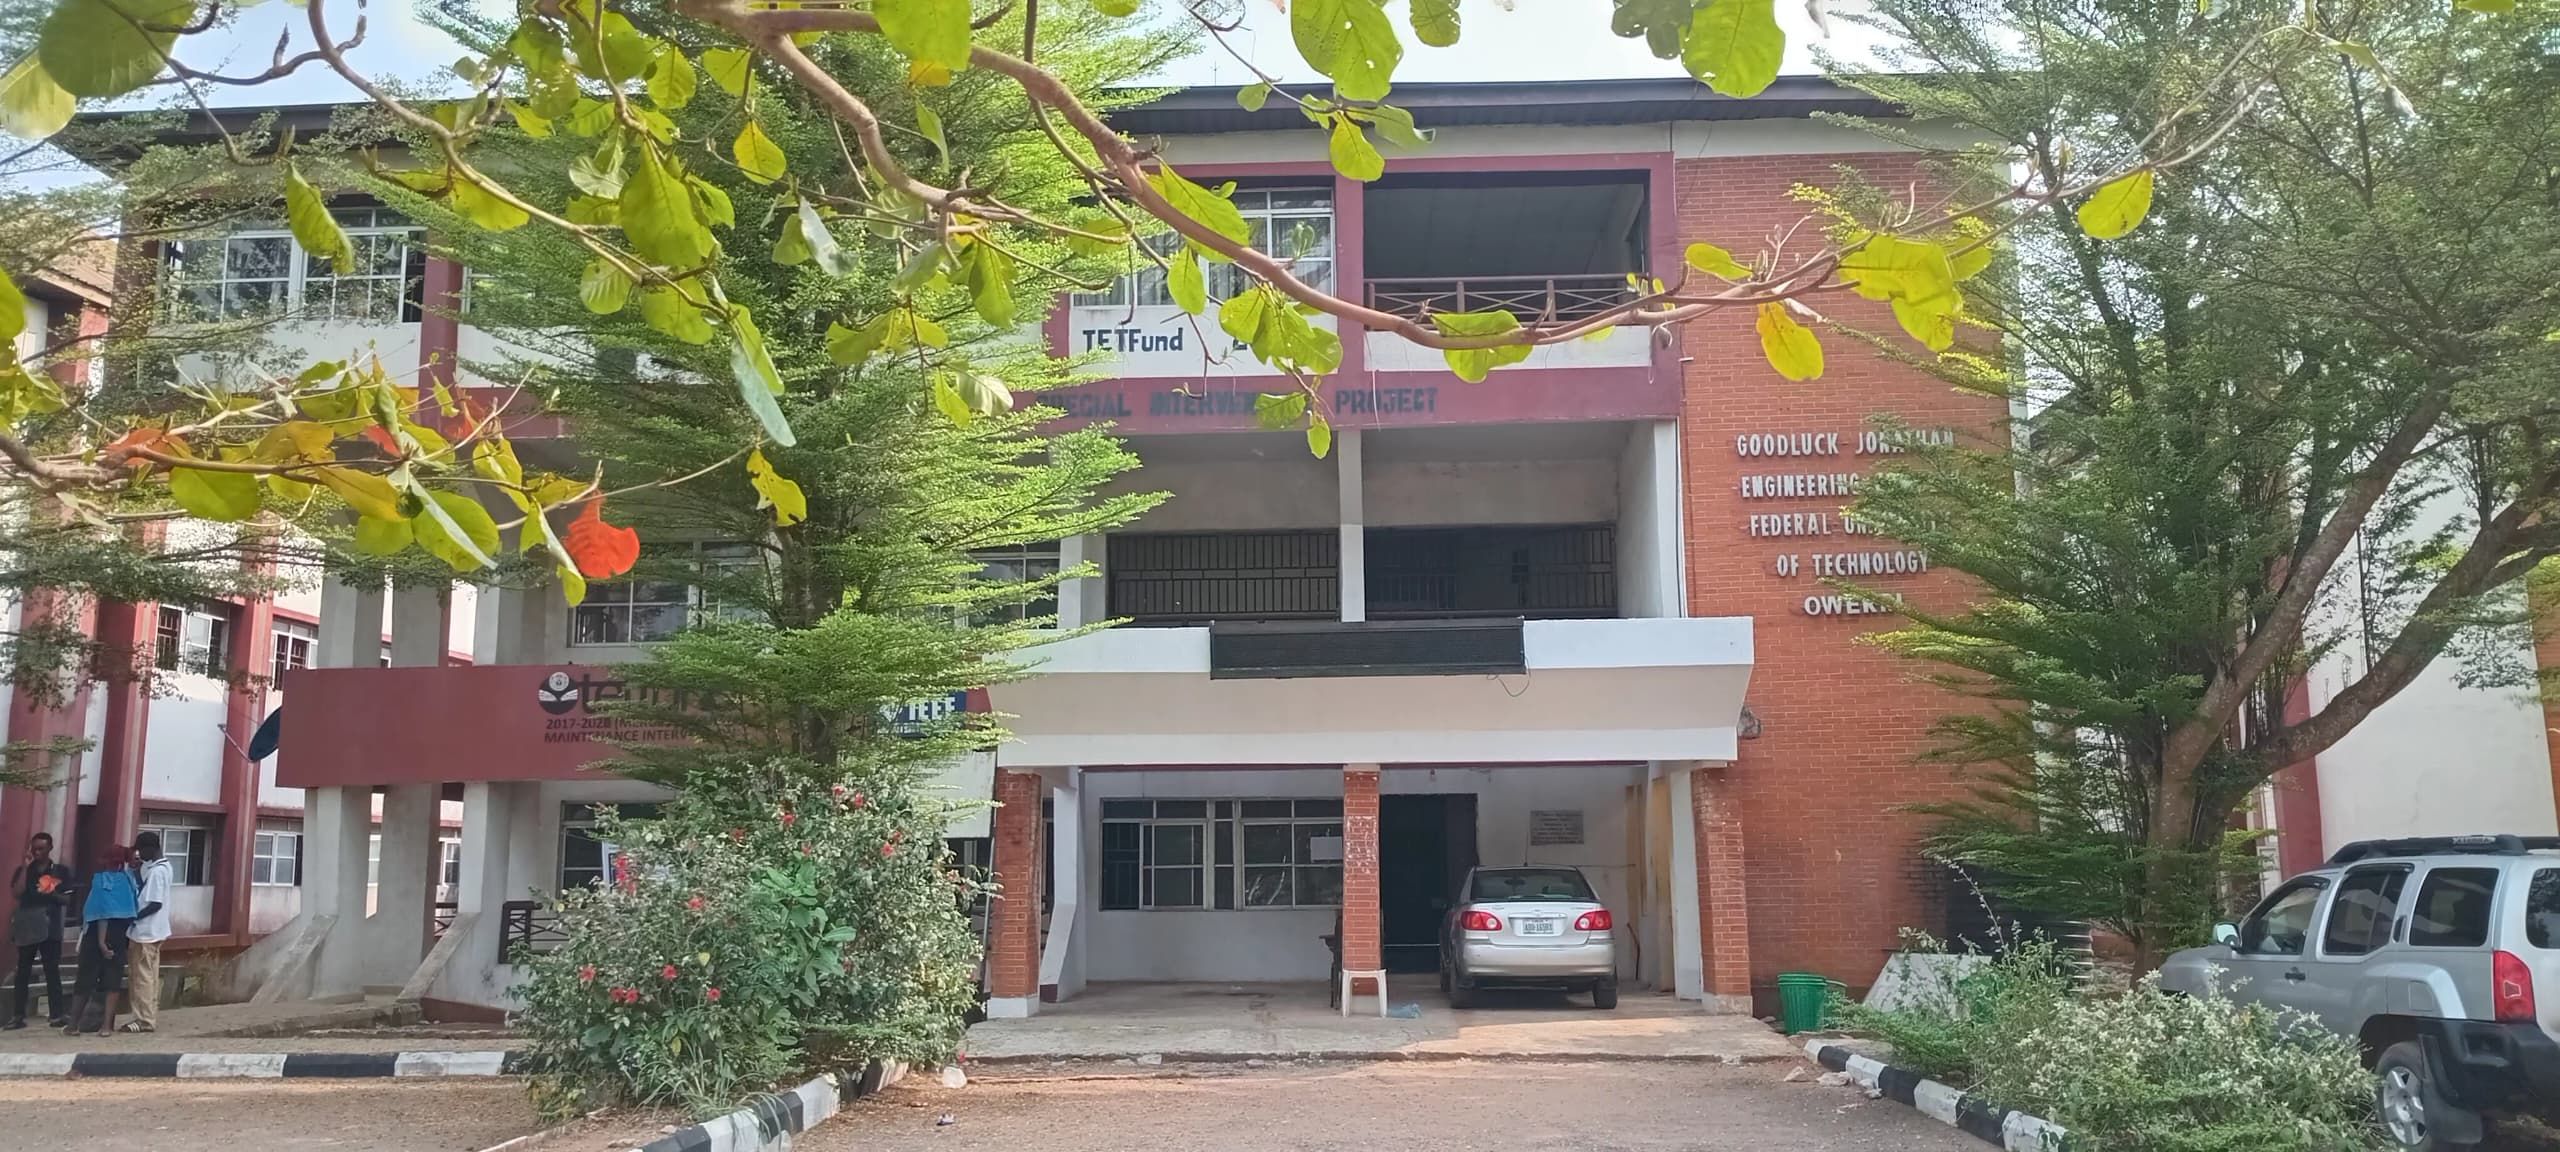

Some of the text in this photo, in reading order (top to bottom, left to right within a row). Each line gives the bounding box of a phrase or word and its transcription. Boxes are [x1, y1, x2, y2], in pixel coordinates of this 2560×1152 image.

[1082, 327, 1184, 353] TETFund
[1335, 387, 1439, 416] PROJECT
[1737, 432, 1840, 457] GOODLUCK
[1751, 513, 1832, 537] FEDERAL
[1777, 550, 1929, 577] OF TECHNOLOGY
